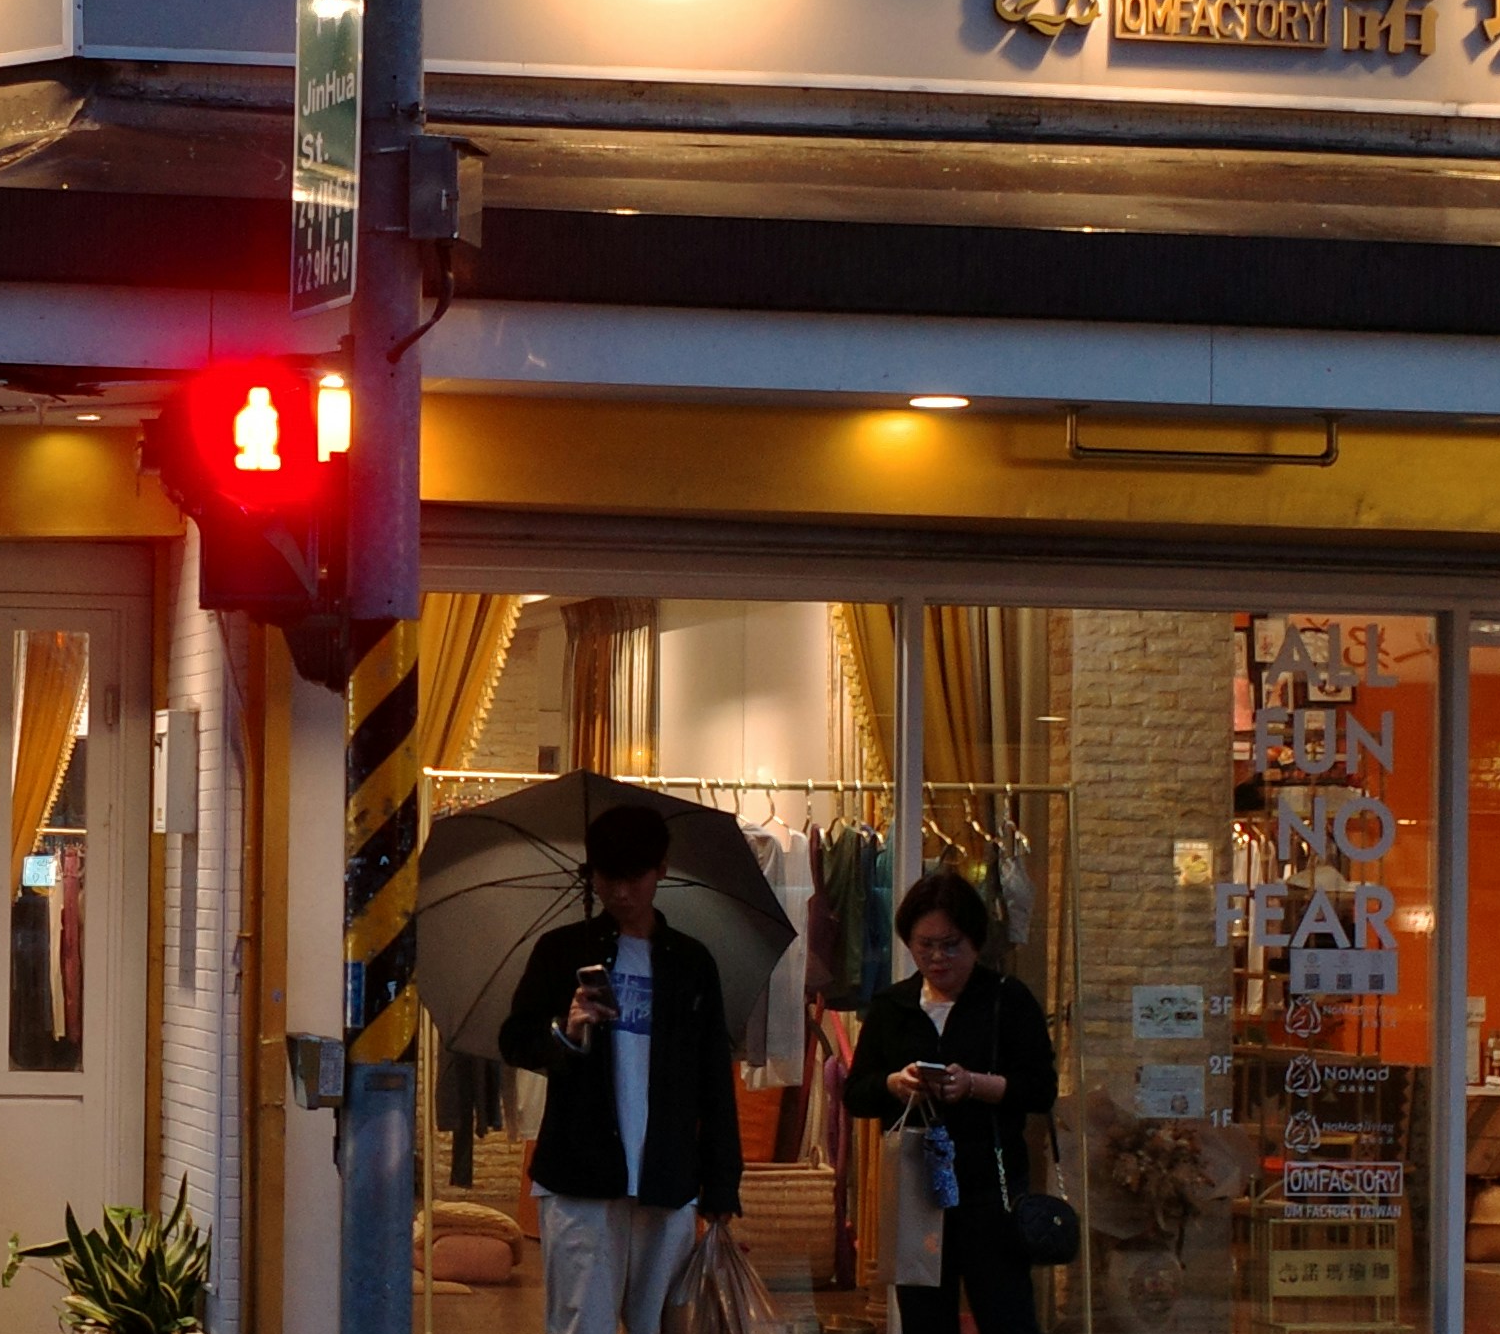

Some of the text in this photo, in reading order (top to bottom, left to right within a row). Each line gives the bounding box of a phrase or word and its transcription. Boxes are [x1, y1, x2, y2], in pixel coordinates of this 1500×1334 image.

[302, 70, 356, 117] JinHua
[301, 133, 329, 169] St.
[297, 239, 350, 295] 229 150
[1266, 623, 1399, 688] ALL
[1253, 709, 1394, 774] FUN
[1278, 797, 1397, 862] NO
[1214, 882, 1399, 949] FEAR
[1209, 996, 1234, 1016] 3F
[1209, 1056, 1233, 1075] 2F
[1323, 1064, 1390, 1083] NoMad
[1209, 1109, 1233, 1127] 1F
[1289, 1168, 1400, 1194] OMFACTORY
